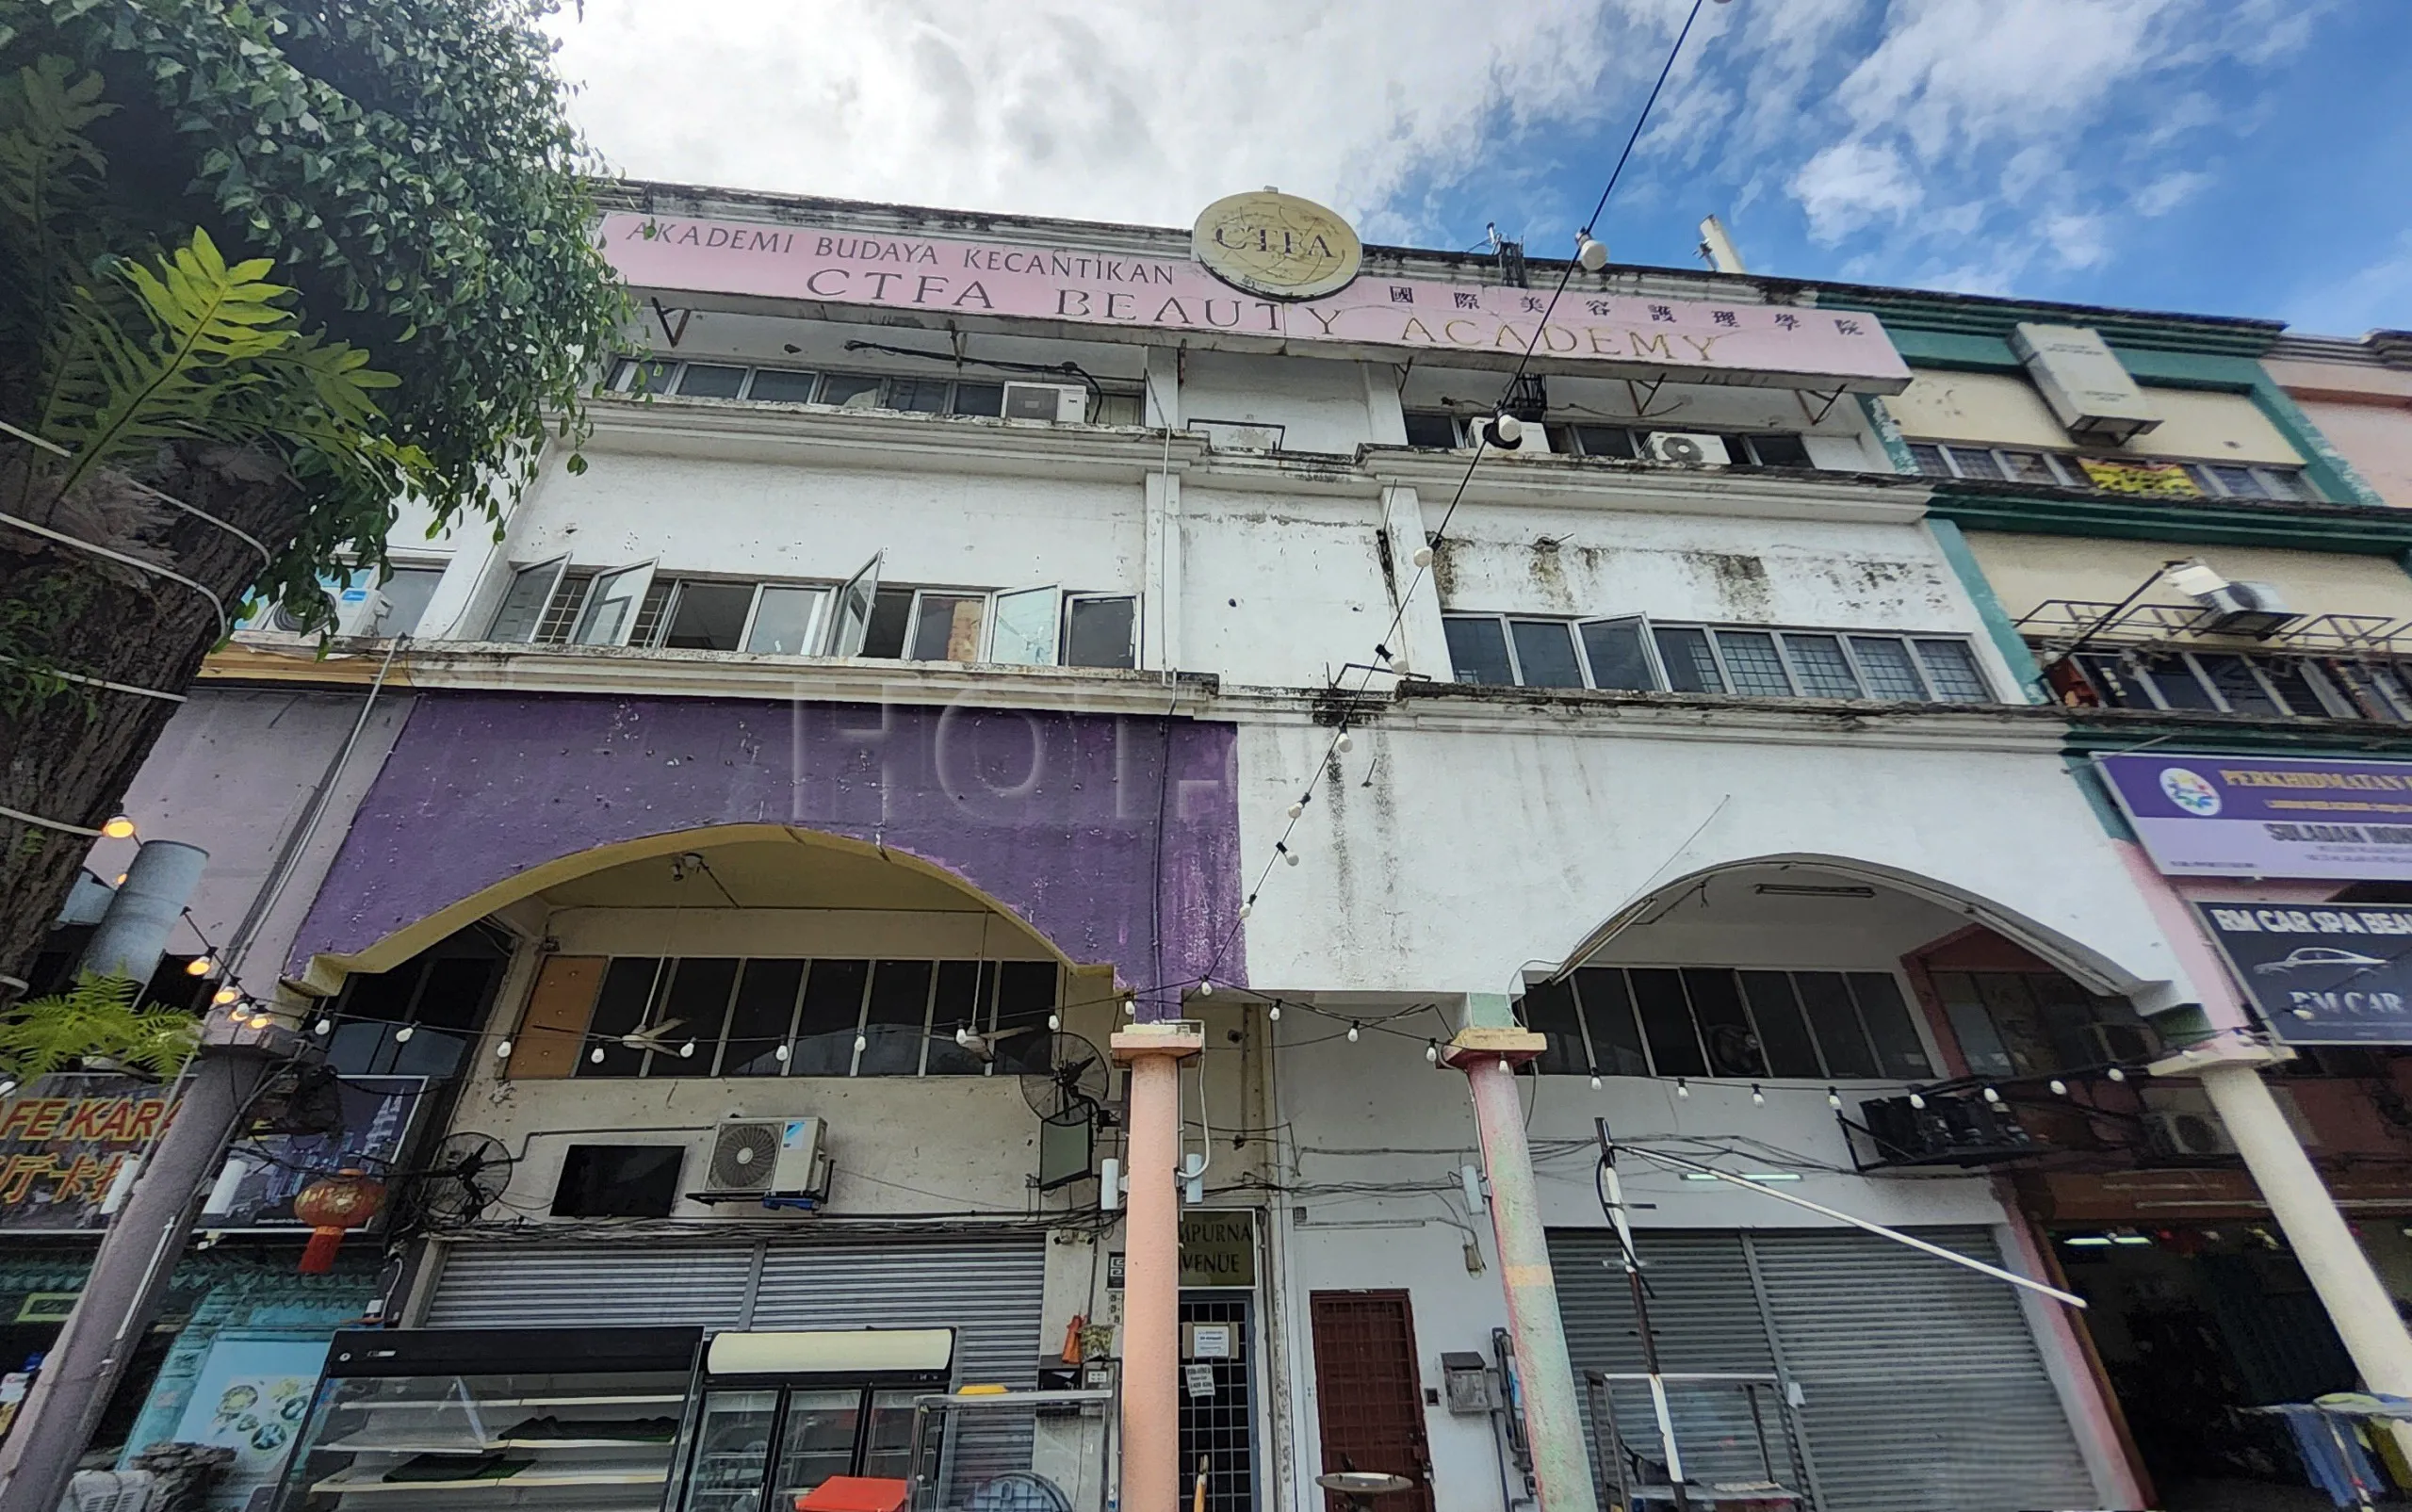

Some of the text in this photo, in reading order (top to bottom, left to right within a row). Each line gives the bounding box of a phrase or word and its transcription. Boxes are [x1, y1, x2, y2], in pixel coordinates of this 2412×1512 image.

[626, 221, 1174, 285] AKADEMI BUDAYA KECANTIKAN
[807, 268, 1718, 362] CTFA BEAUTY ACADEMY
[2256, 910, 2320, 934] CAR
[2310, 911, 2370, 934] SPA
[0, 1098, 68, 1141] FE
